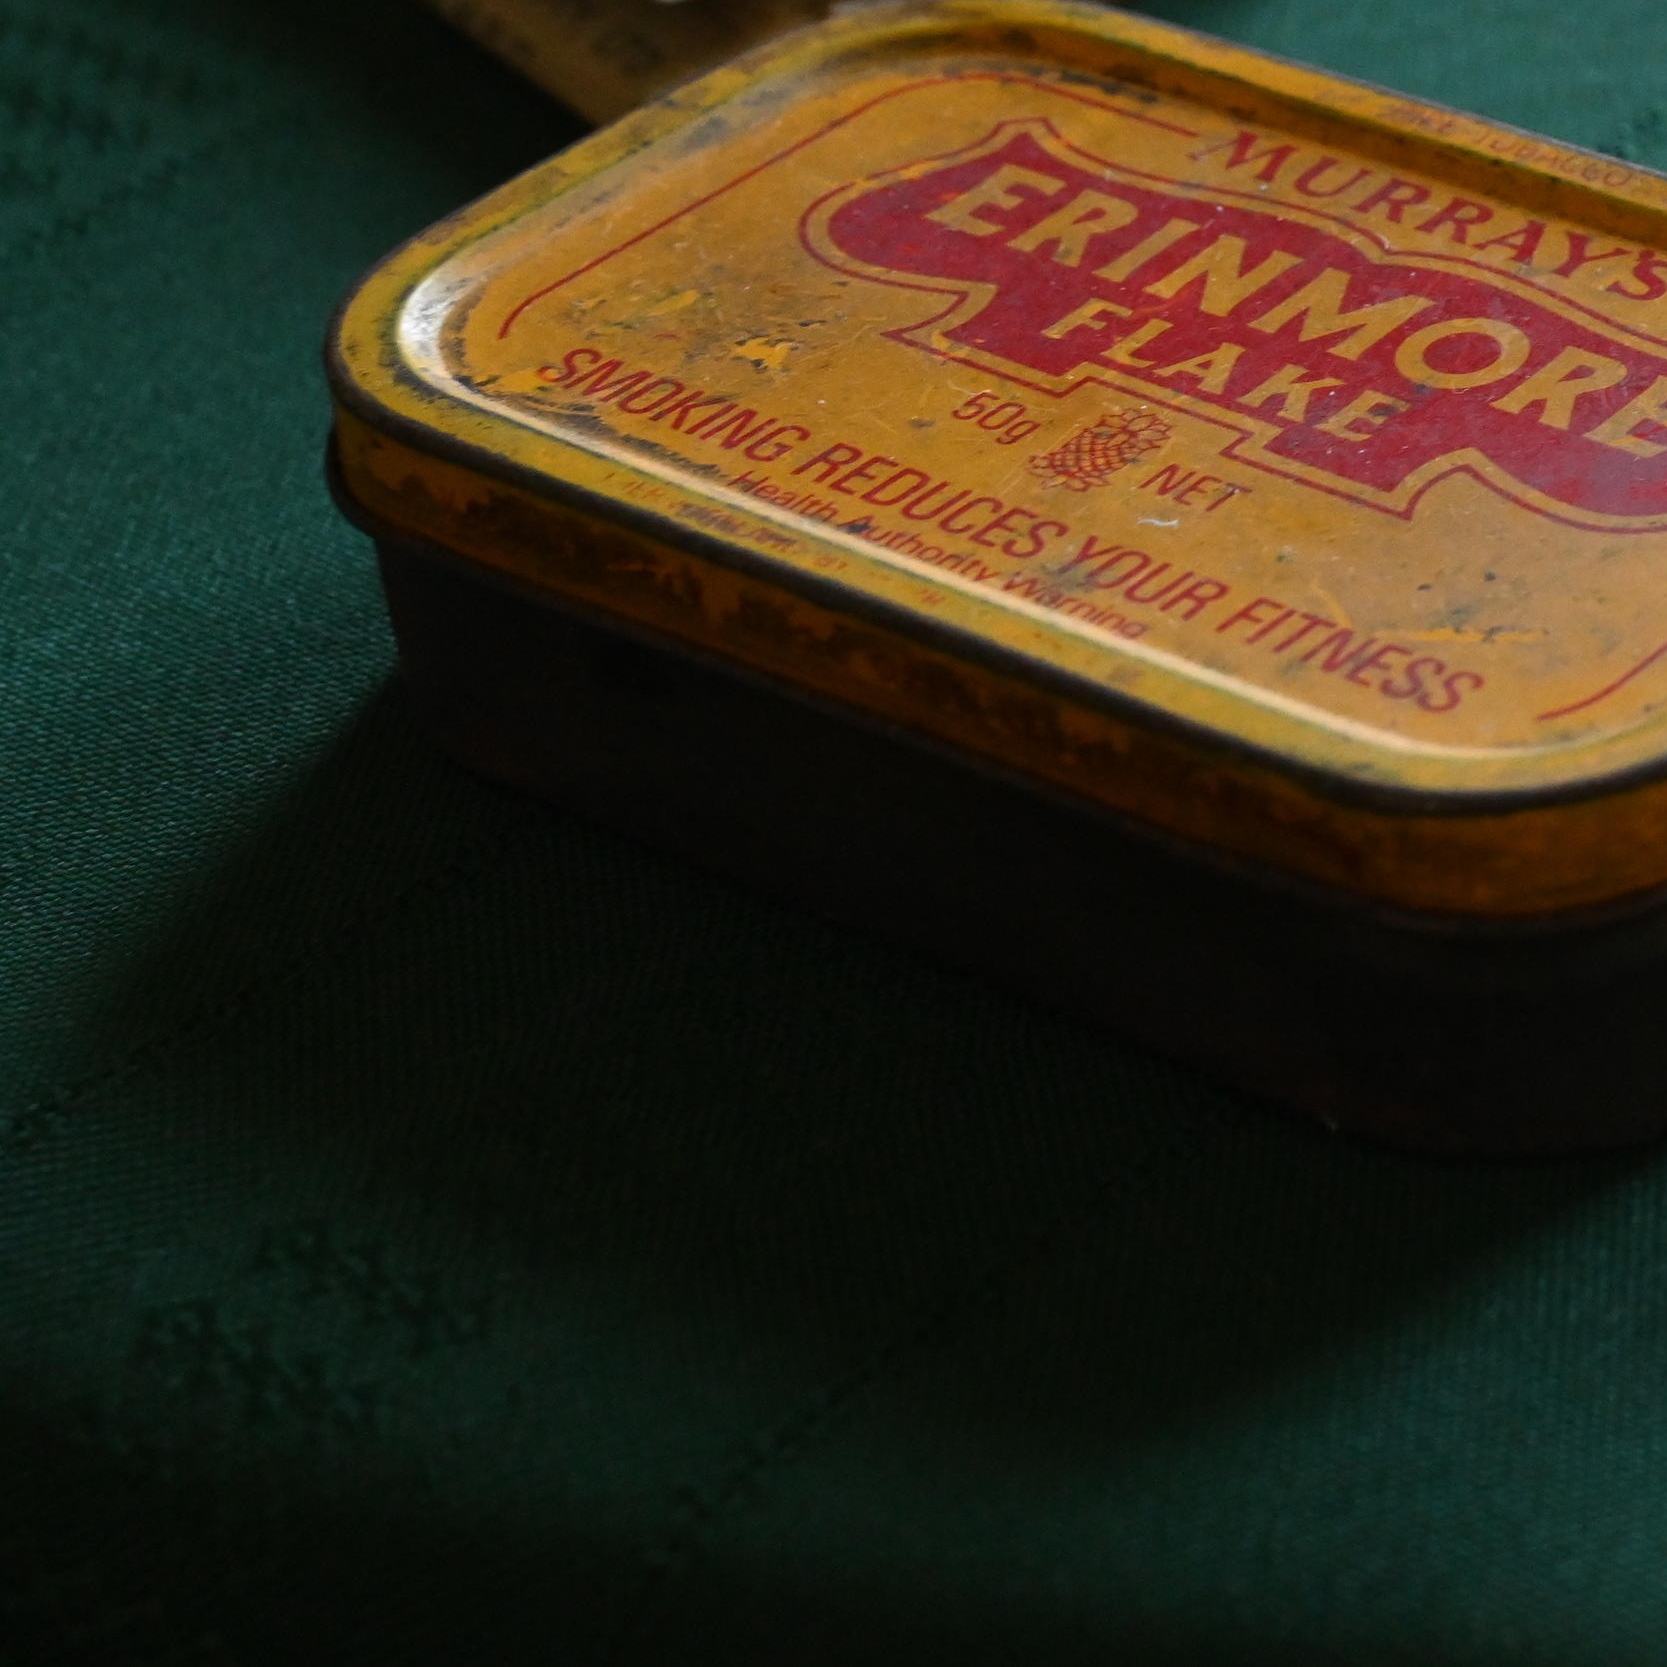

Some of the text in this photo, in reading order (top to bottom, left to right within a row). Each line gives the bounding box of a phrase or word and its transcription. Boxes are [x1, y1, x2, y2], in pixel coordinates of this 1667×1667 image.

[1041, 298, 1411, 442] FLAKE
[952, 389, 1253, 513] 50g NET
[536, 348, 812, 463] SMOKING
[791, 441, 1069, 559] REDUCES
[1057, 534, 1230, 622] YOUR
[1215, 596, 1485, 714] FITNESS
[727, 470, 839, 522] Health
[835, 513, 1003, 584] Authority
[1001, 570, 1151, 642] Warning
